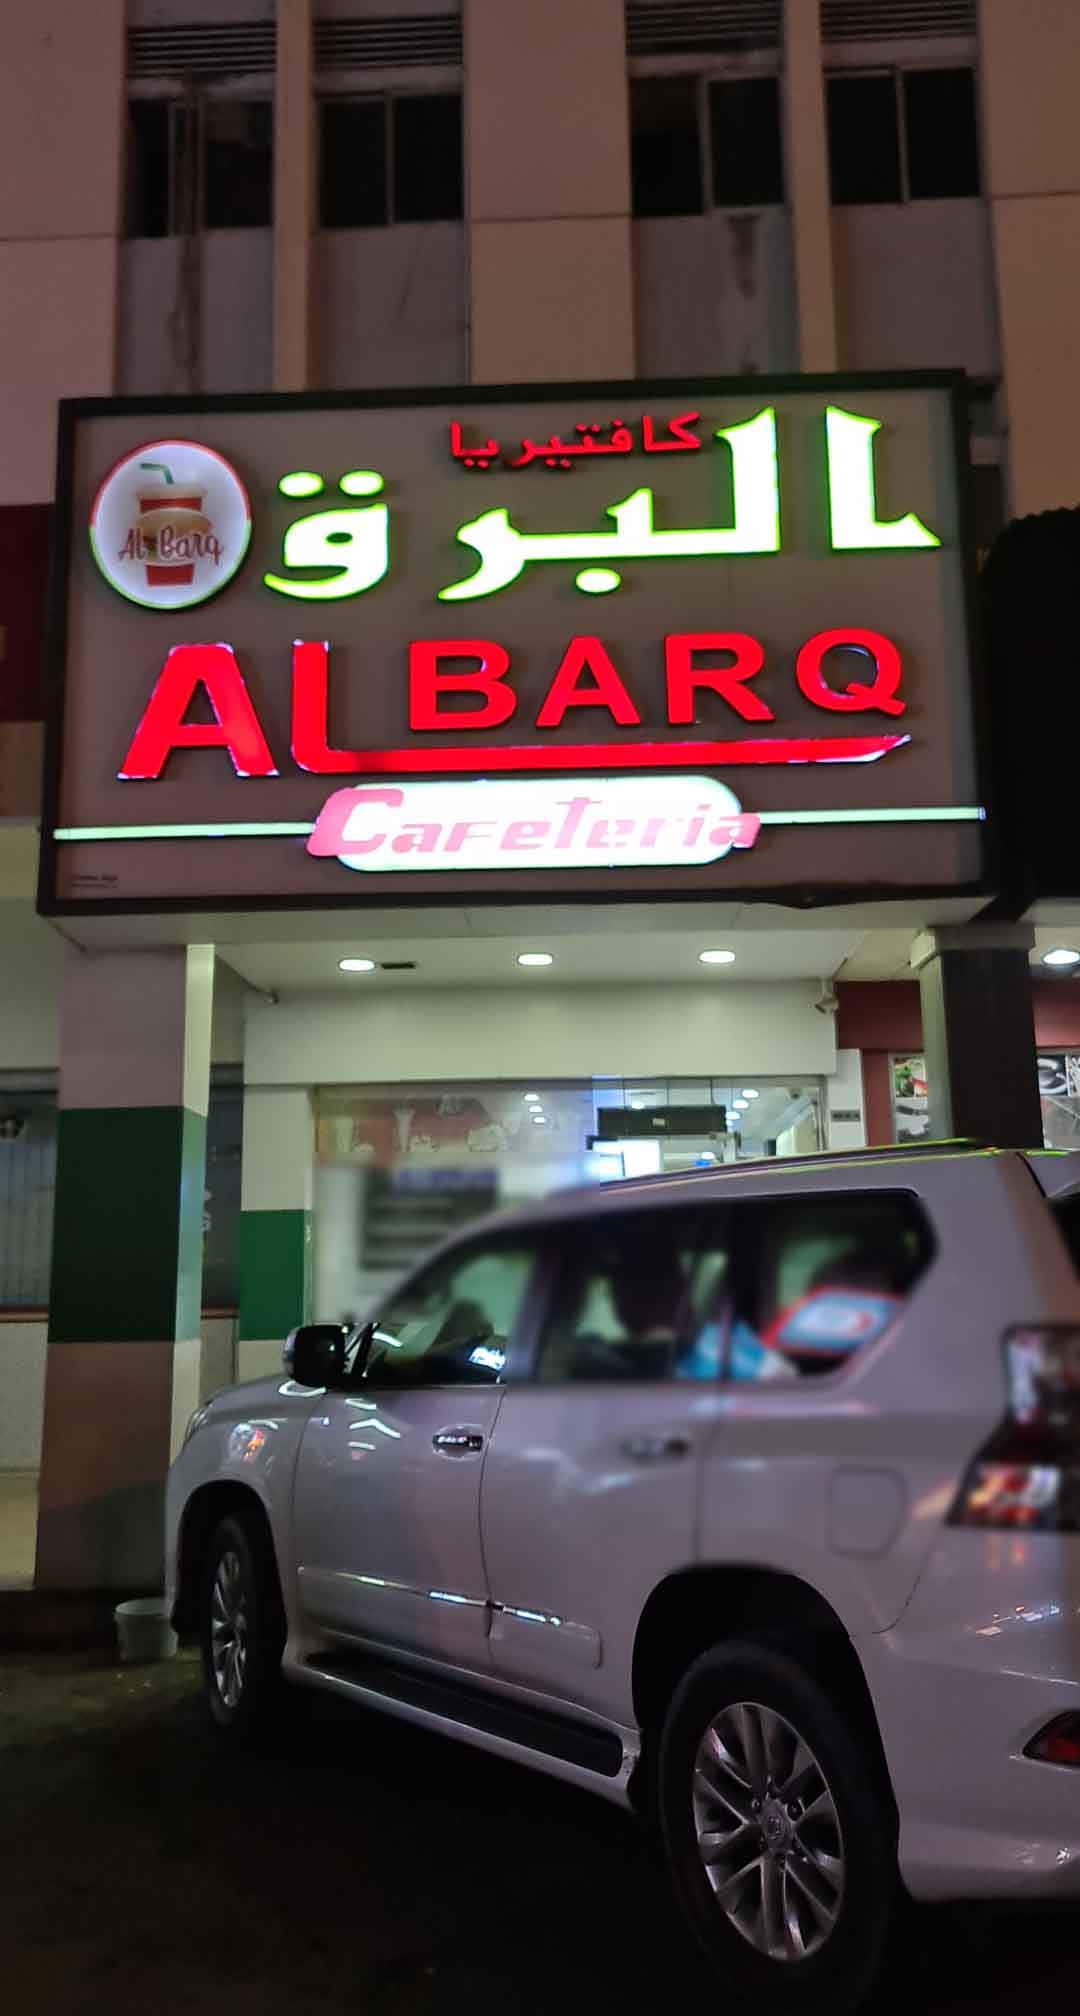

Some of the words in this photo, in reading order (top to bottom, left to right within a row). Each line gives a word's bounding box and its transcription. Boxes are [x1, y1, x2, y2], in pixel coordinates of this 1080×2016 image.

[449, 411, 701, 468] كافتيريا
[264, 405, 941, 600] البرق
[118, 527, 146, 560] Al
